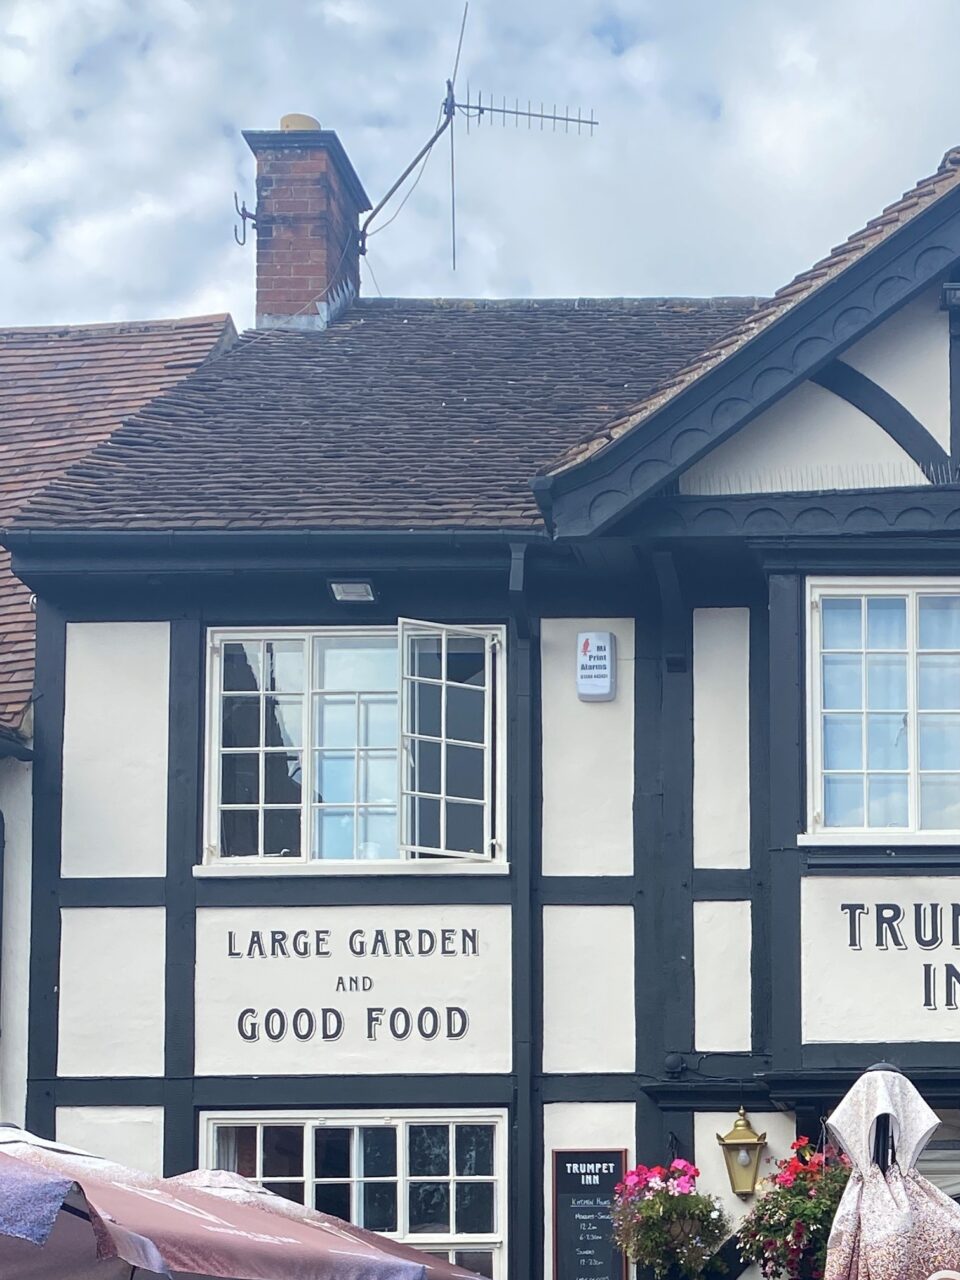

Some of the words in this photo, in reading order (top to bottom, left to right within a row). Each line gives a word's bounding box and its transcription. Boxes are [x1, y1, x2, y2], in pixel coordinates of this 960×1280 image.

[227, 929, 333, 959] LARGE
[348, 928, 481, 957] GARDEN
[335, 976, 374, 993] AND
[237, 1007, 346, 1043] GOOD
[366, 1006, 470, 1042] FOOD
[566, 1163, 615, 1174] TRUMPET
[581, 1174, 600, 1185] INN
